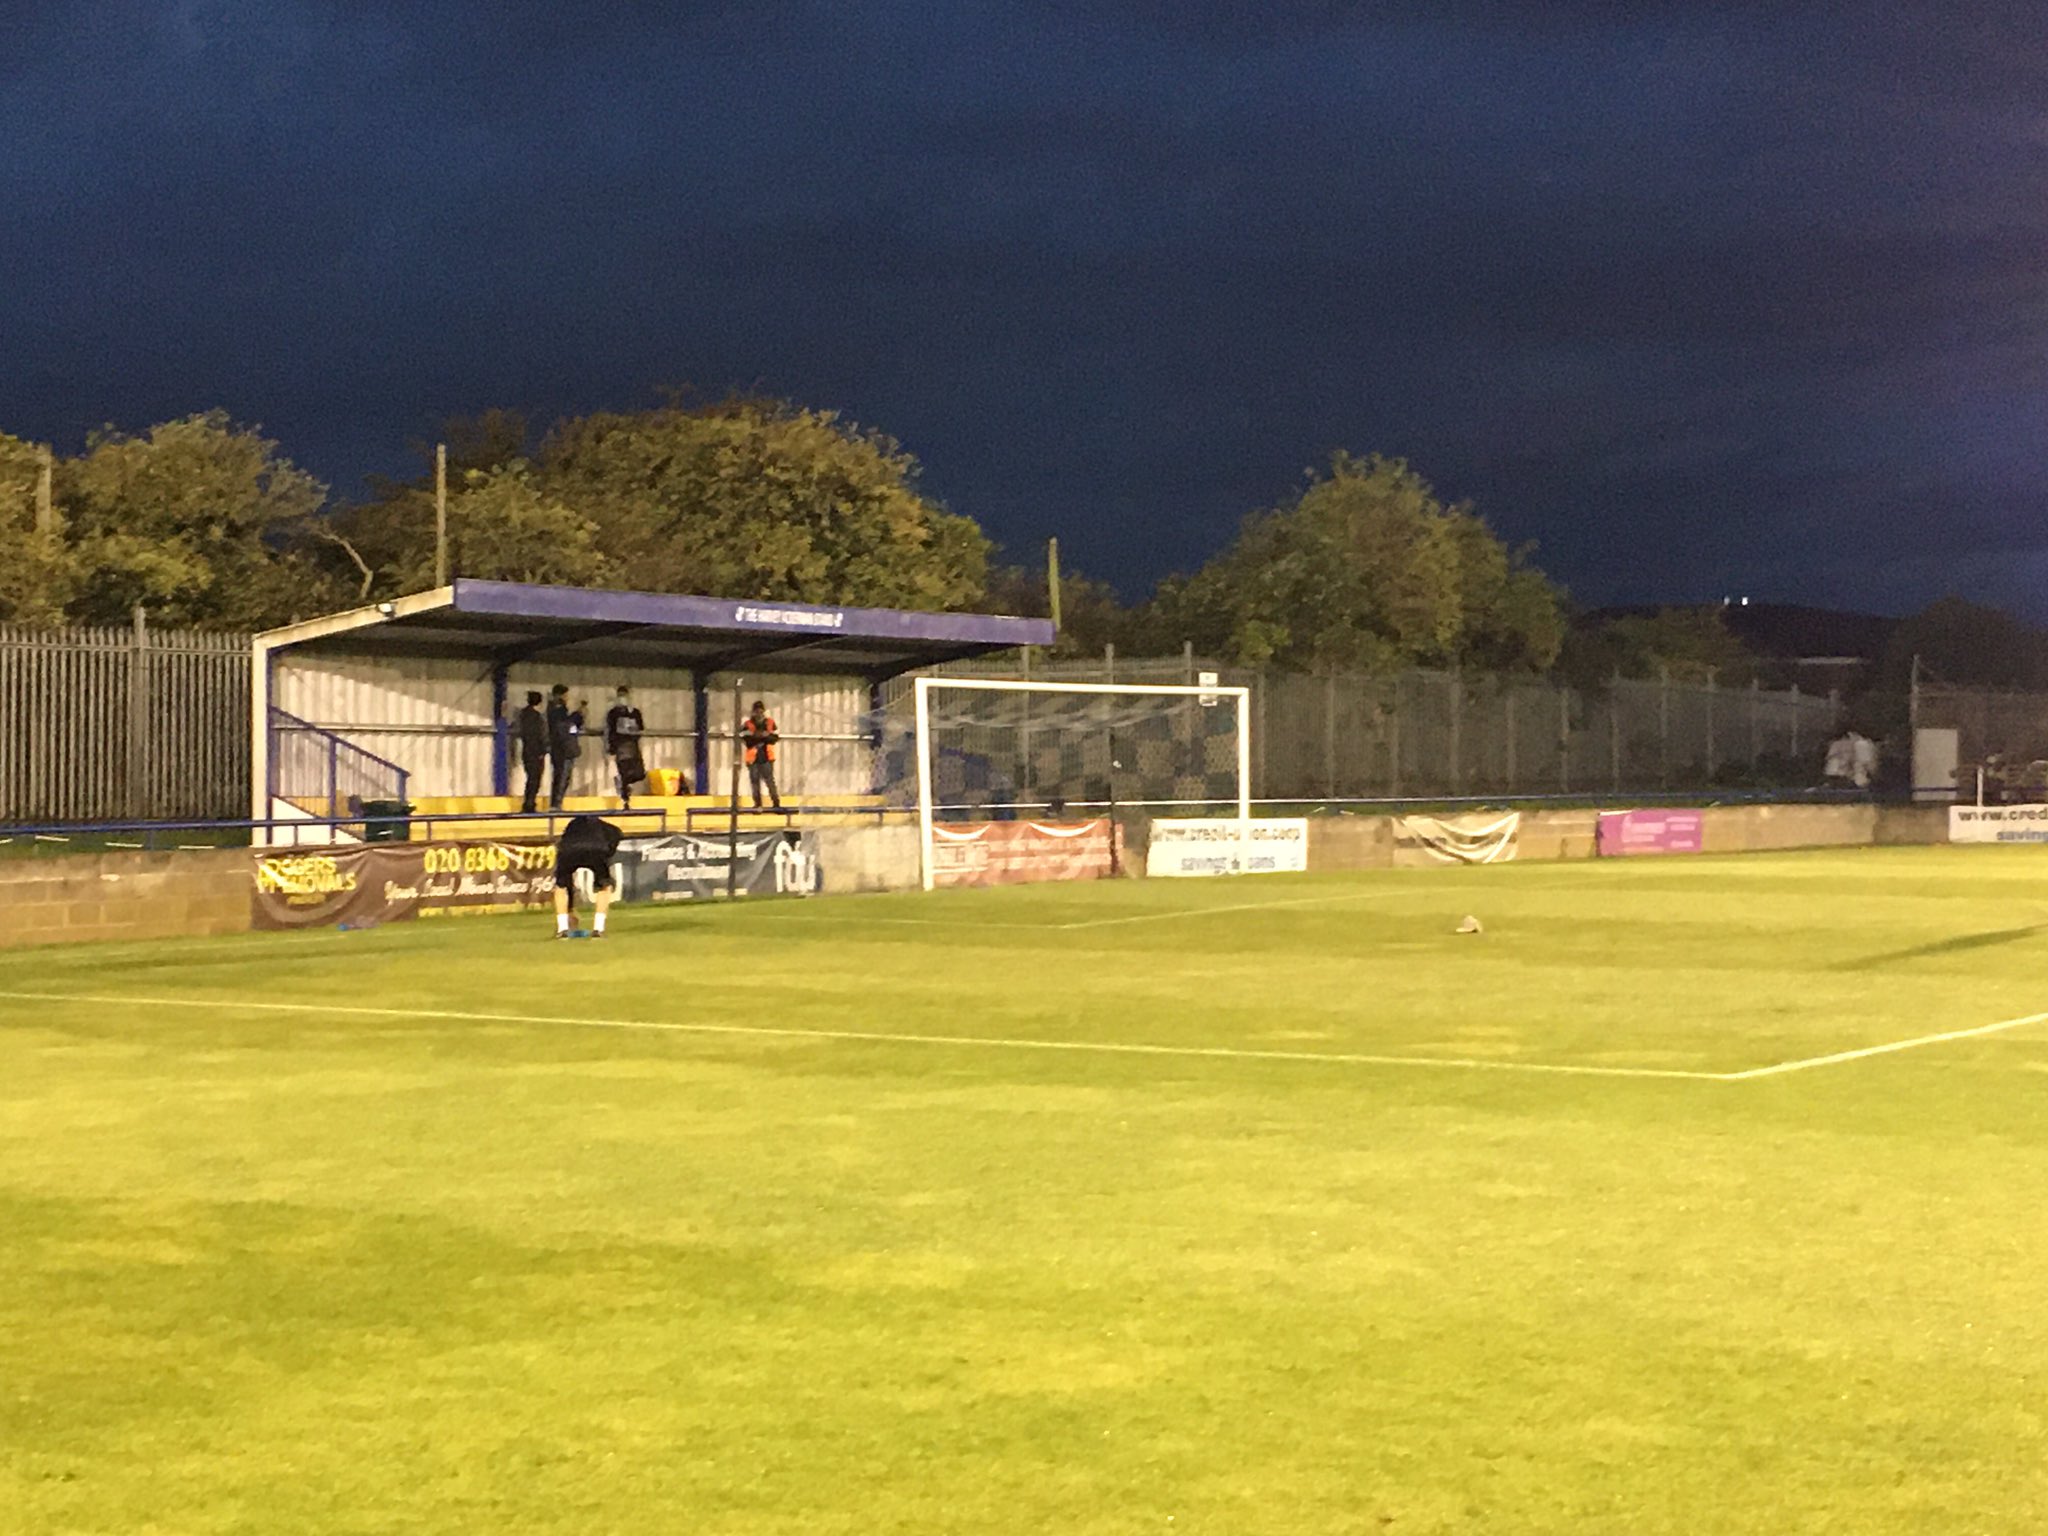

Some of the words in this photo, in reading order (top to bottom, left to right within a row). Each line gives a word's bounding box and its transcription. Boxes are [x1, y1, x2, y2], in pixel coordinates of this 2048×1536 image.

[424, 847, 461, 873] 020
[384, 880, 418, 906] Your
[420, 876, 453, 898] Local
[496, 875, 528, 894] Since
